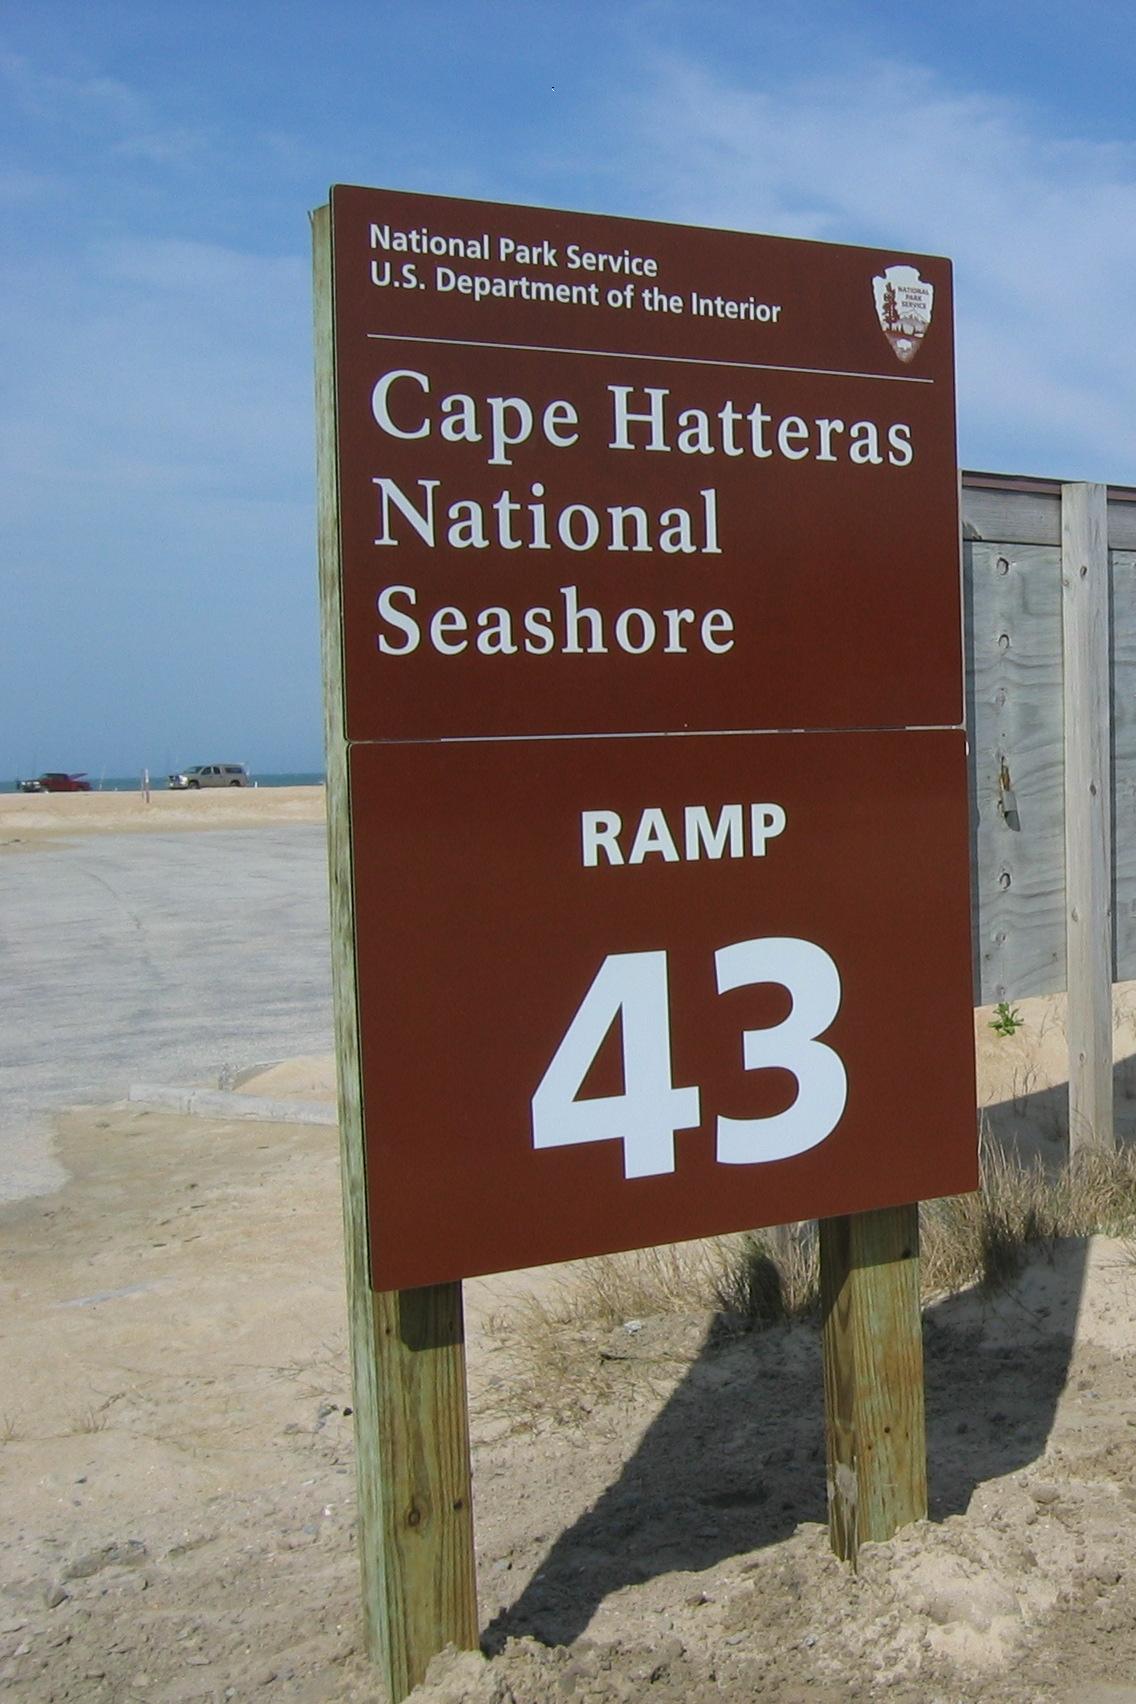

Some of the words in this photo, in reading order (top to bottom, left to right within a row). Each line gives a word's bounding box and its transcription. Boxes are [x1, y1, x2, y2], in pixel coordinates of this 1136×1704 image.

[370, 224, 489, 259] National
[499, 238, 558, 266] Park
[567, 245, 658, 277] Service
[371, 261, 425, 289] U.S.
[437, 267, 599, 305] Department
[607, 284, 634, 308] of
[642, 287, 683, 313] the
[691, 293, 781, 322] Interior
[372, 370, 578, 465] Cape
[608, 384, 914, 466] Hatteras
[374, 477, 722, 553] National
[377, 586, 735, 655] Seashore
[582, 803, 786, 867] RAMP
[532, 937, 847, 1179] 43
